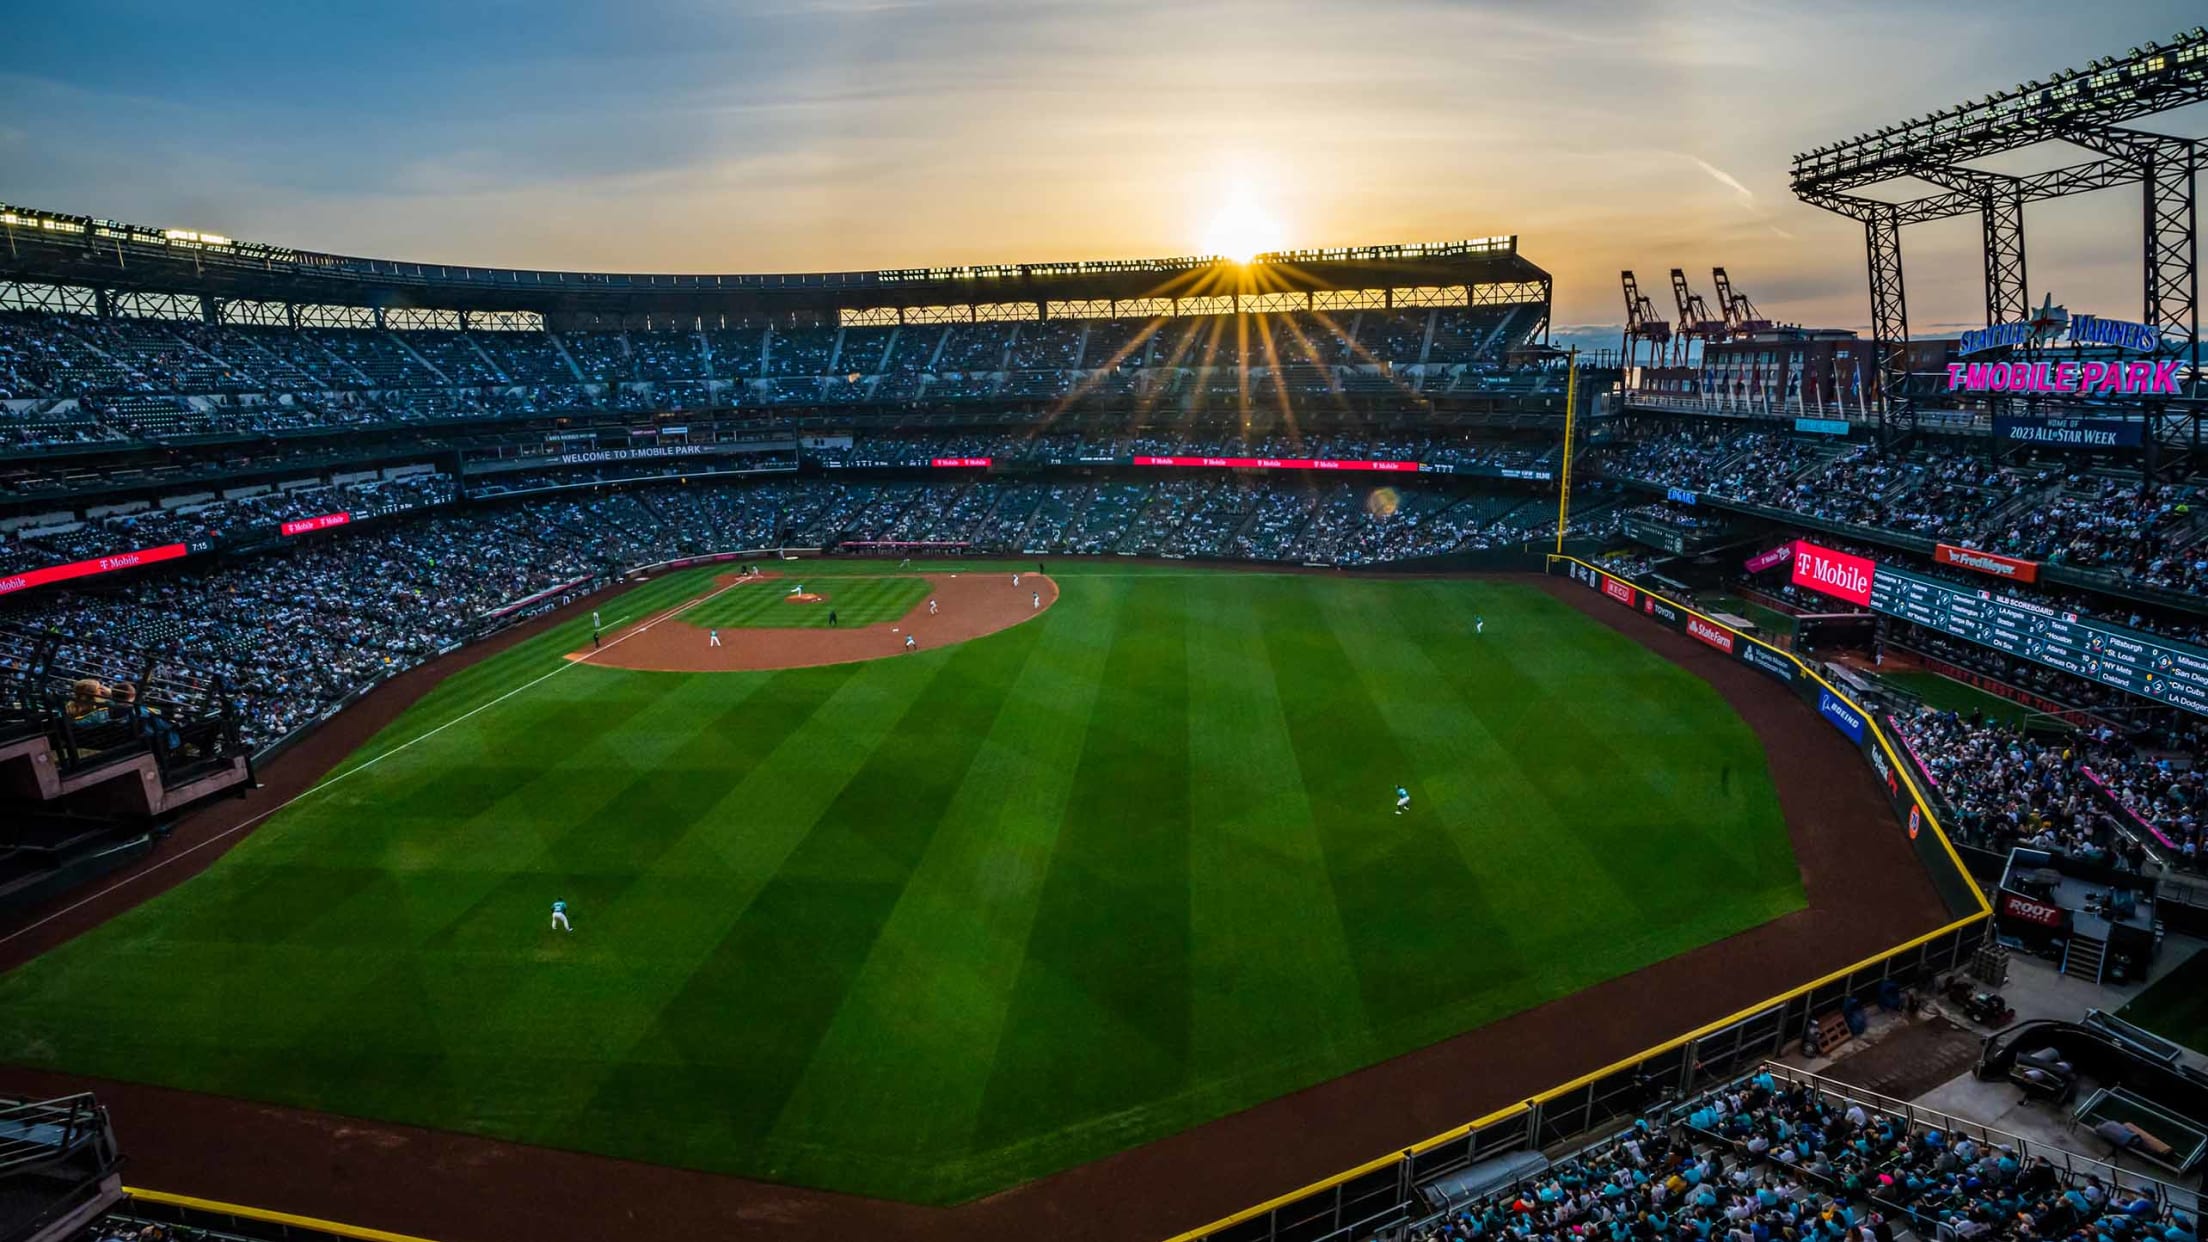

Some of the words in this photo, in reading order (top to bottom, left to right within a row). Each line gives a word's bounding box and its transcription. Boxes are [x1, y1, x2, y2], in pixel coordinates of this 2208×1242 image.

[1960, 322, 2030, 355] SEATTLE
[2069, 314, 2158, 352] MARINERS
[1946, 361, 2081, 394] T-MOBILE
[2080, 361, 2187, 395] PARK
[2009, 426, 2034, 440] 2023
[2083, 428, 2117, 445] WEEK
[562, 451, 611, 463] WELCOME
[615, 449, 627, 460] TO
[676, 445, 702, 456] PARK
[191, 542, 208, 552] 7:15
[110, 555, 139, 569] Mobile
[1813, 556, 1868, 594] Mobile
[1654, 603, 1676, 621] TOYOTA
[2009, 597, 2054, 616] SCOREBOARD
[2051, 621, 2068, 632] Texas
[2050, 633, 2073, 645] Houston
[2109, 637, 2143, 653] Pittsburgh
[2046, 643, 2067, 656] Atlanta
[2118, 651, 2136, 663] Louis
[2045, 654, 2065, 667] Kansas
[2065, 662, 2078, 673] City
[2104, 661, 2116, 672] NY
[2115, 663, 2132, 676] Mets
[2175, 667, 2190, 680] San
[2102, 673, 2130, 687] Oakland
[2144, 685, 2150, 693] 0
[2172, 681, 2185, 692] Chi
[2185, 686, 2206, 699] Cubs
[2168, 694, 2180, 704] LA
[1831, 702, 1860, 729] BOEING
[2007, 898, 2057, 919] ROOT
